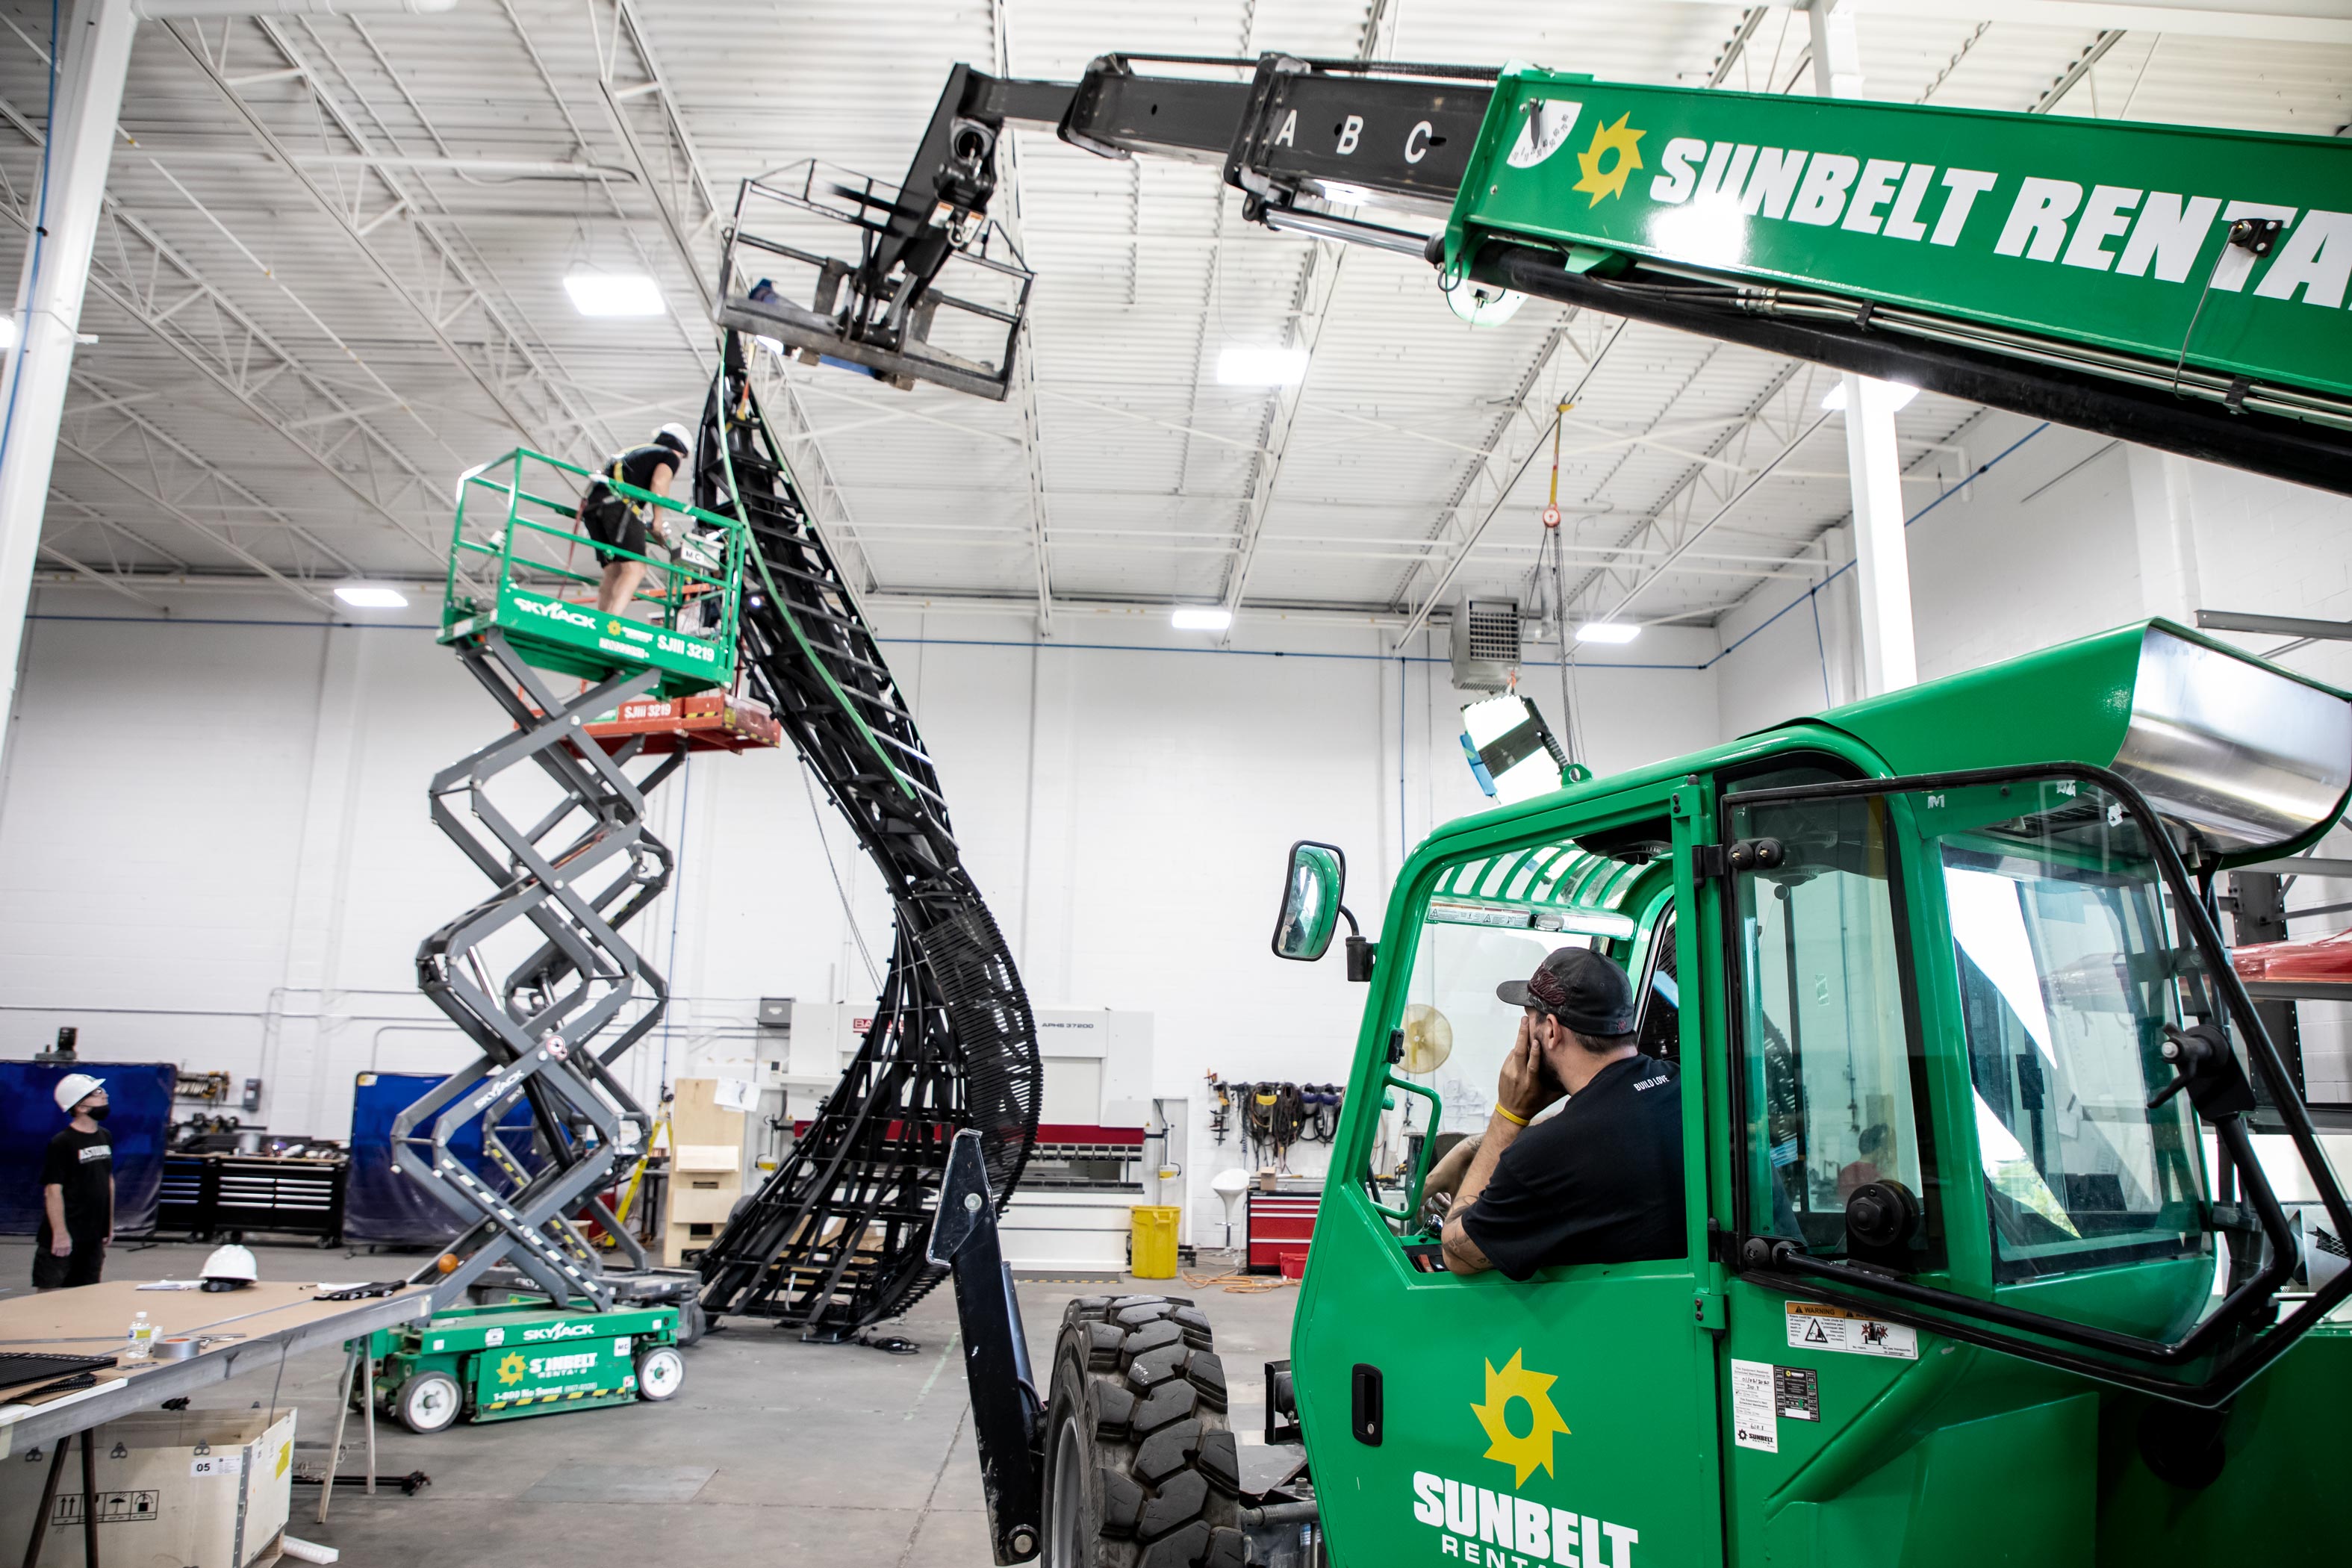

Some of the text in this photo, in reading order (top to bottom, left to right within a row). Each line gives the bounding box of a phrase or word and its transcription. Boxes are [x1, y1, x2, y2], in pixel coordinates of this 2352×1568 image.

[1275, 109, 1433, 164] A B C
[1649, 137, 2352, 311] SUNBELT RENTA
[513, 597, 597, 630] SKYJACK
[686, 642, 715, 662] 3219
[647, 703, 671, 718] 3219
[1633, 1074, 1670, 1092] BUILD LOVE
[1805, 1307, 1835, 1316] WARNING
[523, 1322, 595, 1341] SKYJACK
[1749, 1433, 1774, 1443] SUNBELT
[196, 1463, 211, 1472] 05
[1413, 1471, 1639, 1568] SUNBELT
[1442, 1534, 1549, 1568] RENT
